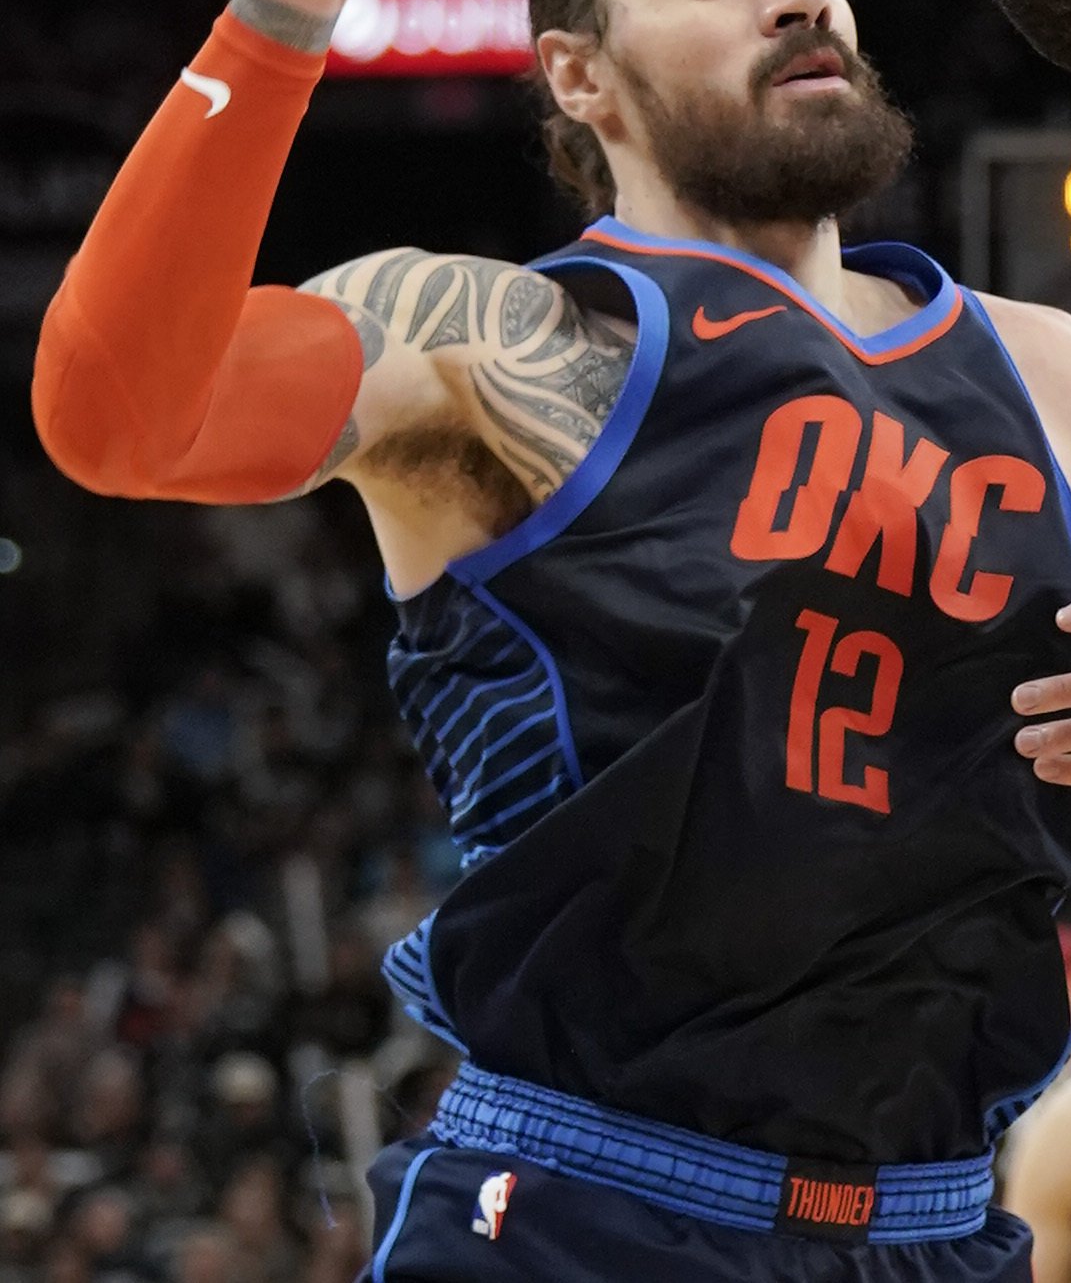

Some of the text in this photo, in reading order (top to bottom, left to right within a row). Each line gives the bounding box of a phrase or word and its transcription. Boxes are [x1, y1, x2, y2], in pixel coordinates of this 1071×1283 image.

[729, 394, 1046, 623] OKC
[786, 608, 904, 815] 12
[787, 1177, 875, 1226] THUNDER
